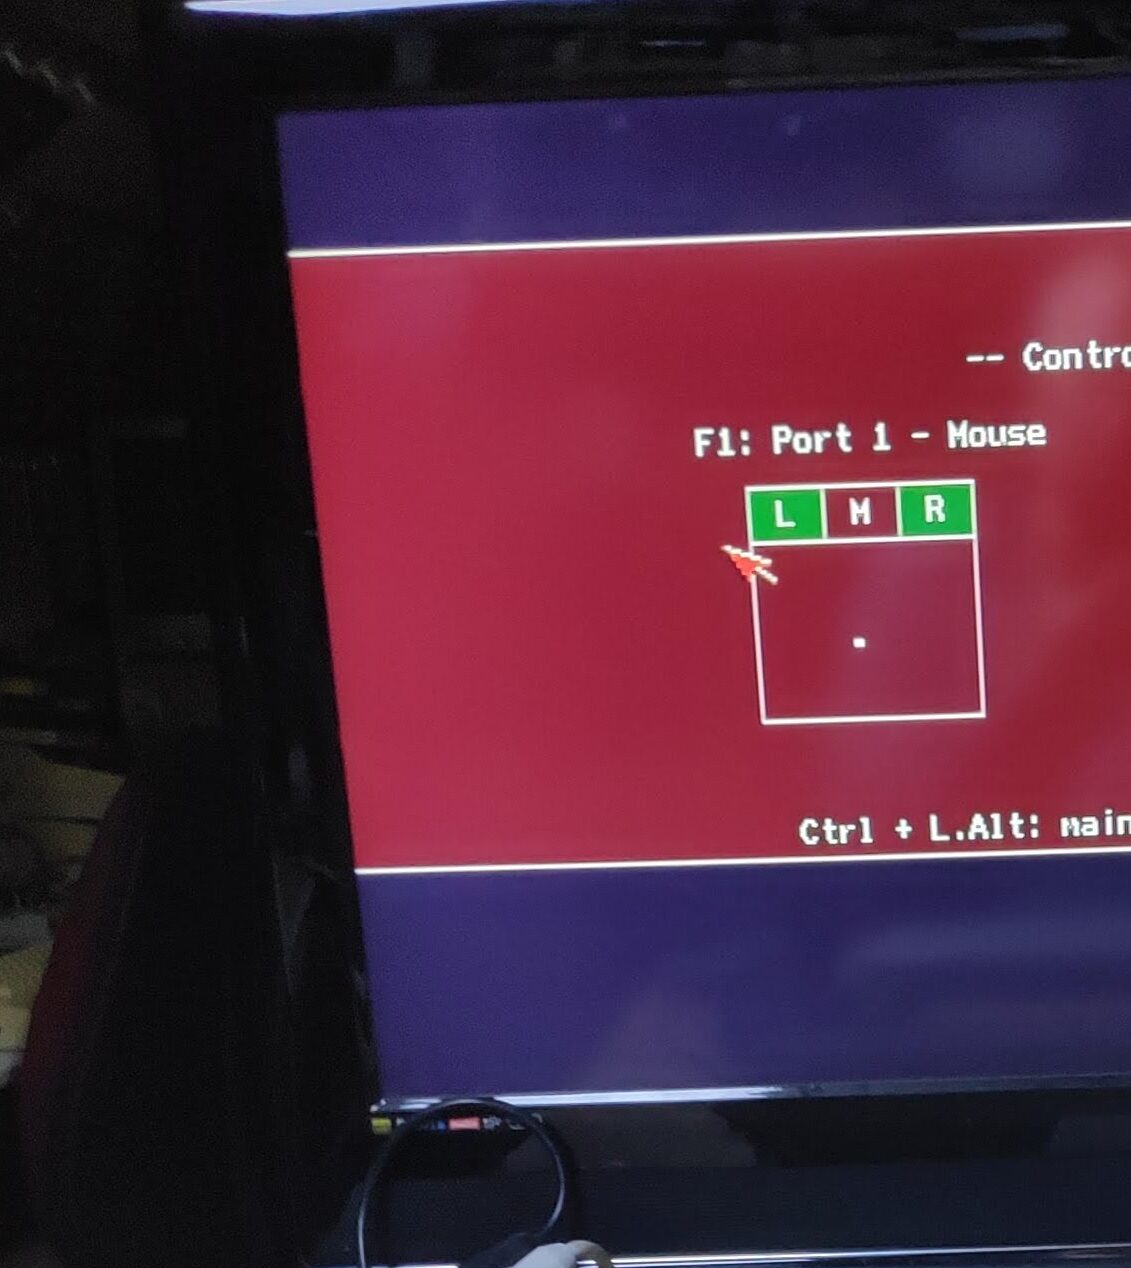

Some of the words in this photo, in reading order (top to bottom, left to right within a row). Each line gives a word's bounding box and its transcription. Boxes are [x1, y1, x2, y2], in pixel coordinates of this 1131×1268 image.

[693, 426, 751, 458] F1:
[771, 422, 853, 455] Port
[872, 421, 892, 452] 1
[946, 418, 1048, 449] Mouse
[774, 499, 796, 528] L
[848, 496, 872, 526] M
[923, 494, 946, 523] R
[798, 816, 874, 846] Ctrl
[894, 818, 913, 840] +
[929, 811, 1039, 842] L.Alt:
